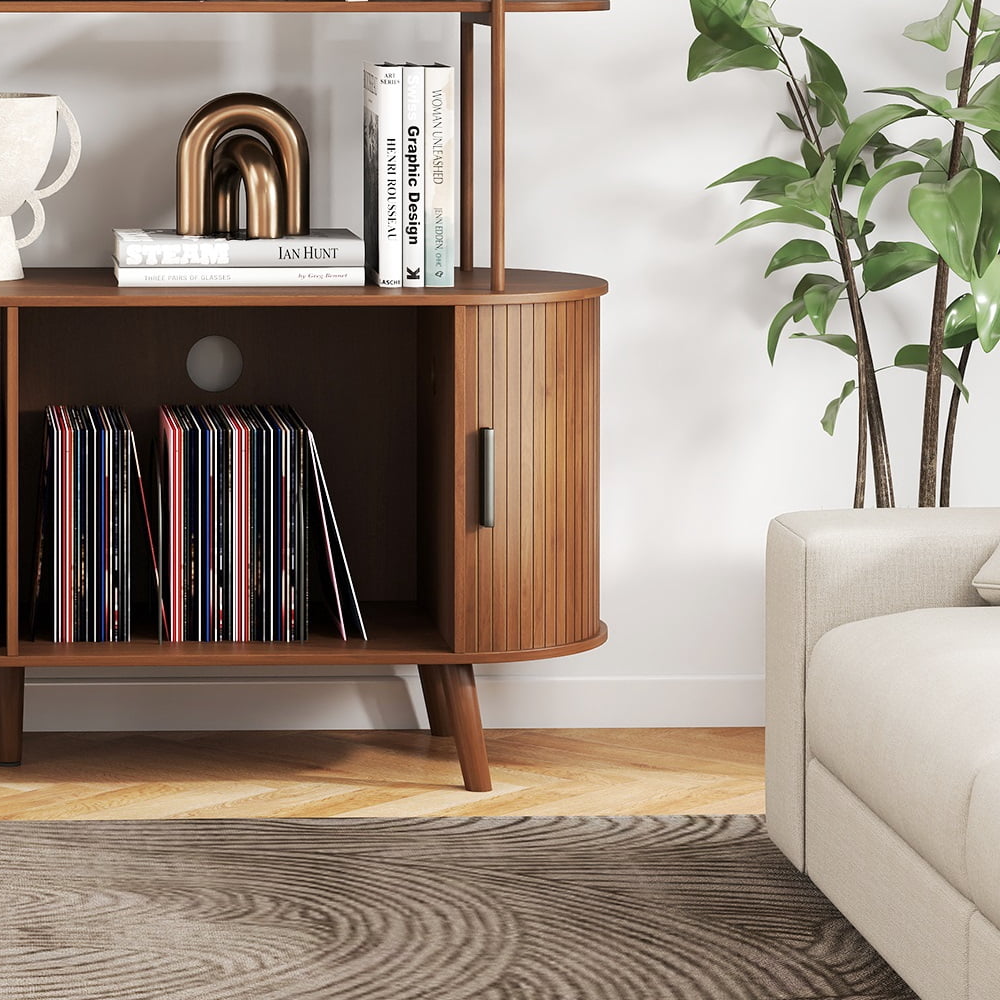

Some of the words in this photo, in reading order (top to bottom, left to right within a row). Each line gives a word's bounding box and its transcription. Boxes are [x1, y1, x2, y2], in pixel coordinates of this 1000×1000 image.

[407, 75, 420, 121] Swiss
[432, 90, 442, 129] WOMAN
[387, 138, 396, 176] HENRI
[405, 126, 420, 186] Graphic
[432, 131, 443, 185] UNLEASHED
[387, 179, 397, 240] ROUSSEAU
[406, 192, 420, 245] Design
[126, 242, 229, 265] STEAM
